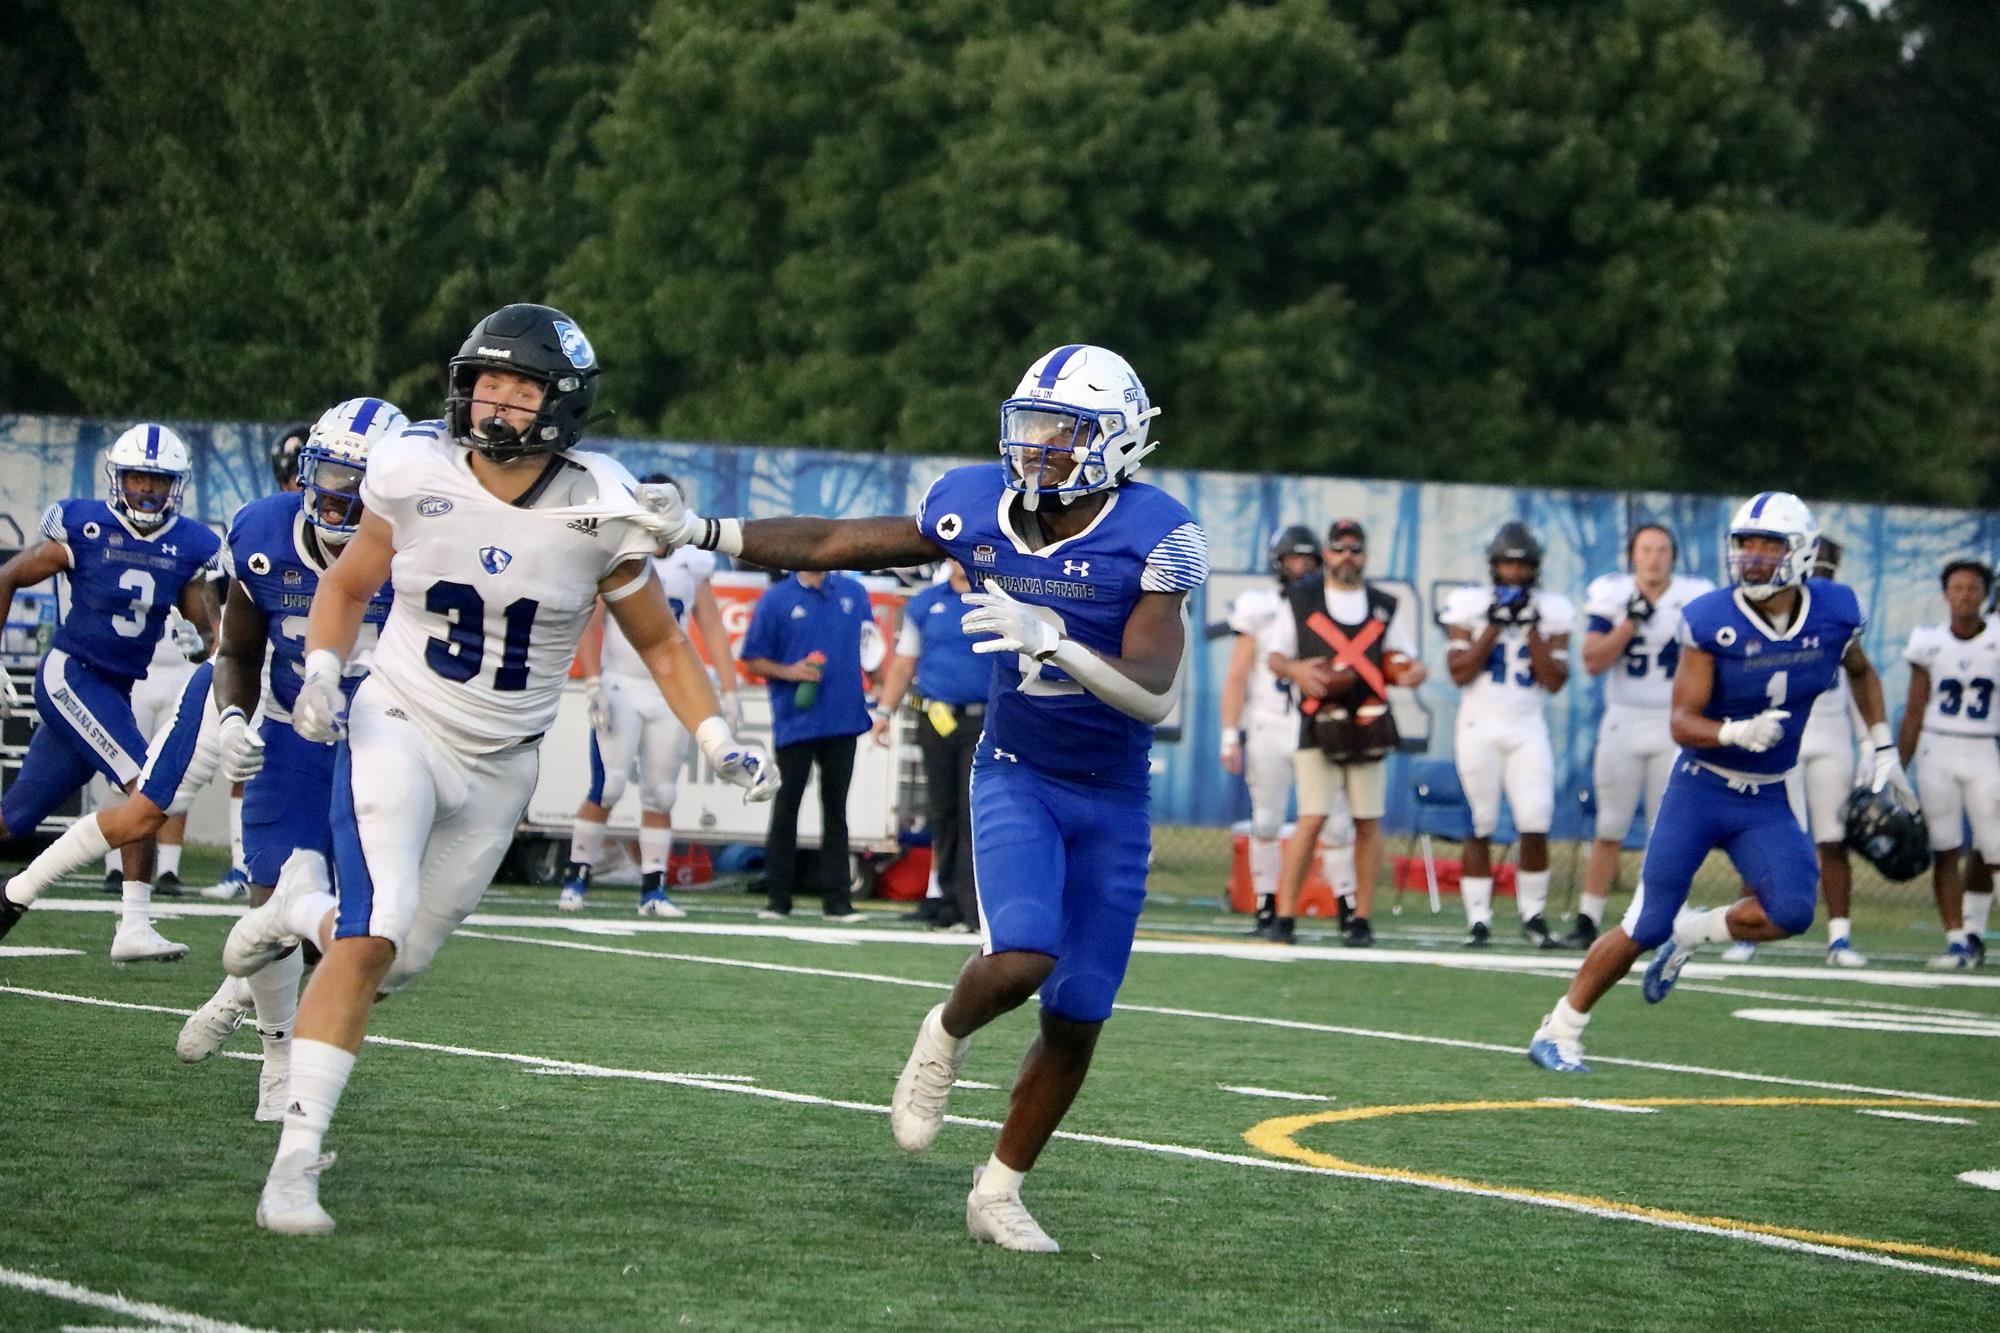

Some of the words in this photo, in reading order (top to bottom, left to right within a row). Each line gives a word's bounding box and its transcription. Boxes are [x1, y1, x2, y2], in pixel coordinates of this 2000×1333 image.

[567, 522, 599, 538] adidas
[111, 568, 156, 638] 3
[1045, 580, 1095, 599] STATE
[424, 580, 540, 691] 31
[1623, 635, 1680, 679] 54
[1485, 642, 1536, 687] 43
[1766, 671, 1788, 709] 1
[1938, 677, 1994, 720] 33
[90, 727, 119, 759] STATE
